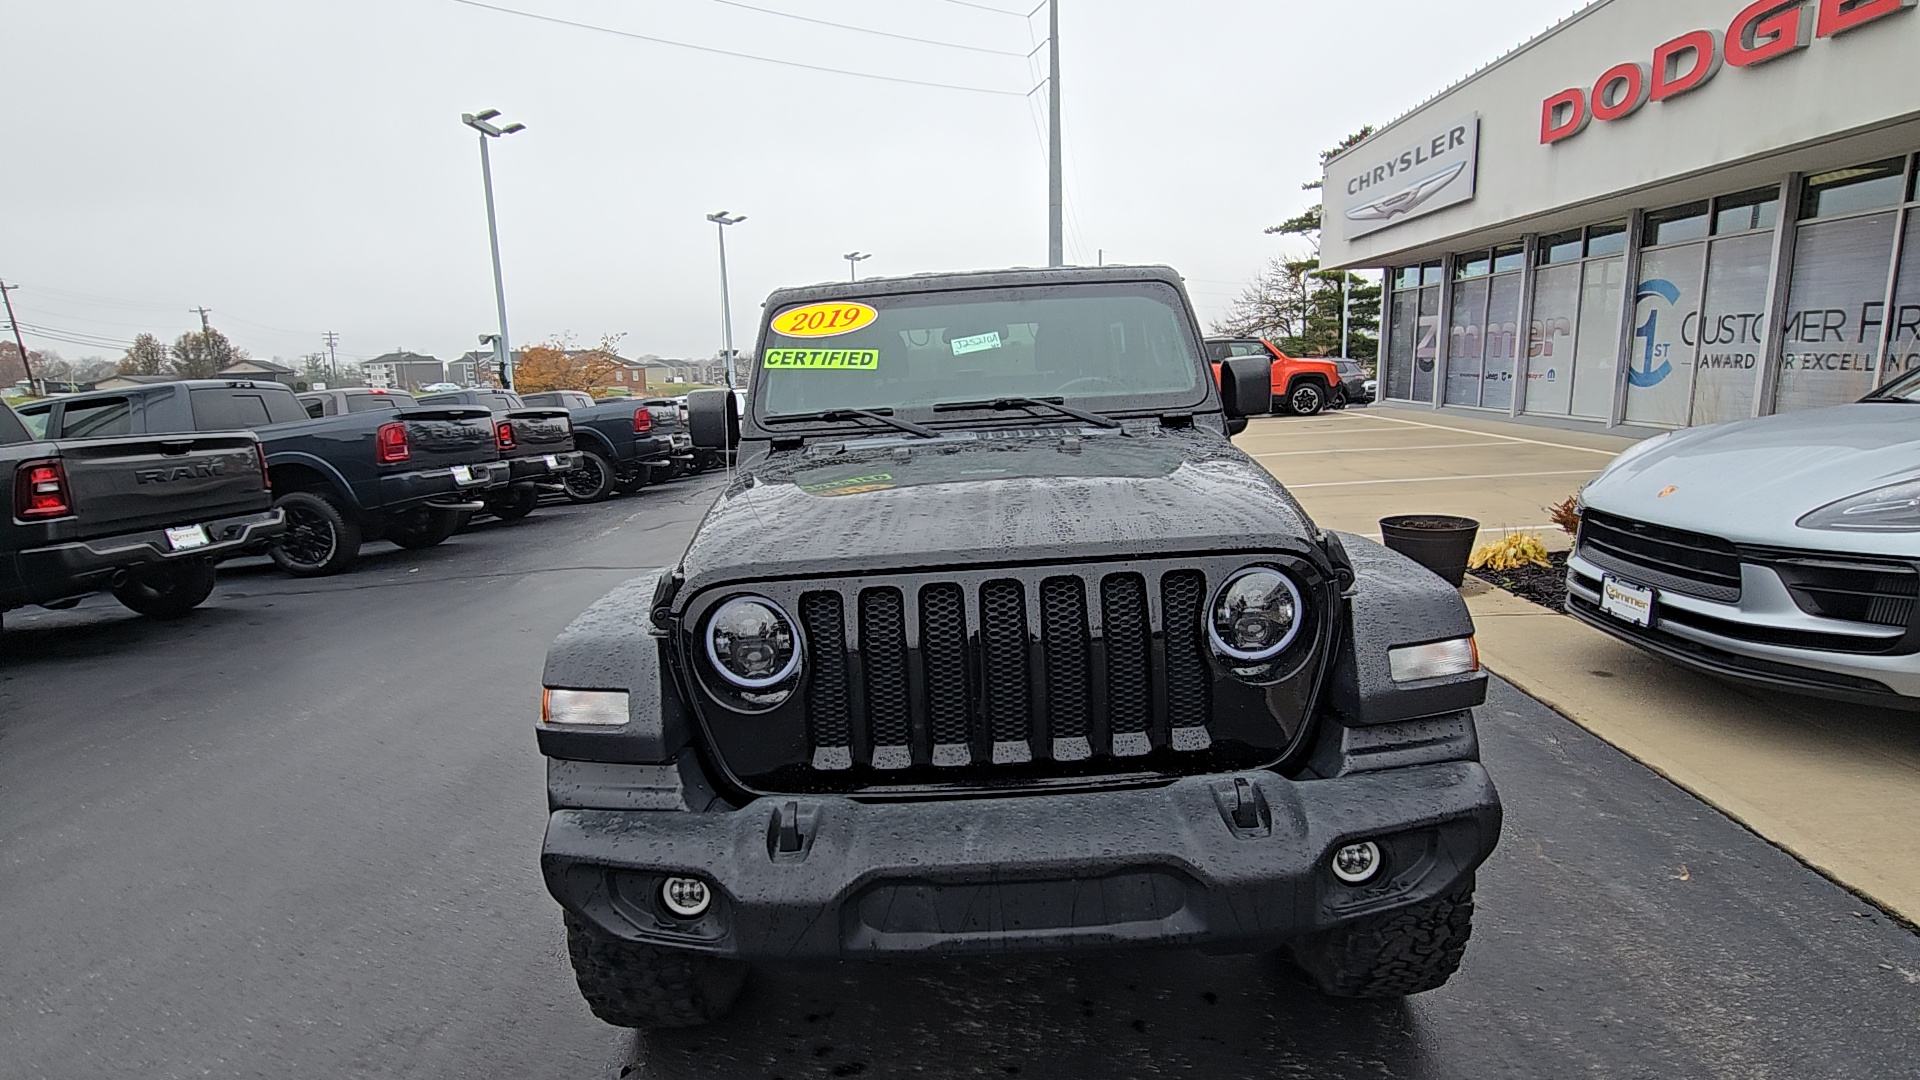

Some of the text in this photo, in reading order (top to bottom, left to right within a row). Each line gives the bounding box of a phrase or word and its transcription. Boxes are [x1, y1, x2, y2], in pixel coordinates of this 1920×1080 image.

[1347, 126, 1466, 196] CHRYSLER
[789, 307, 860, 332] 2019
[1416, 315, 1571, 359] Zmmer
[766, 351, 873, 366] CERTIFIED
[1699, 353, 1756, 370] AWARD
[135, 463, 225, 485] RAM
